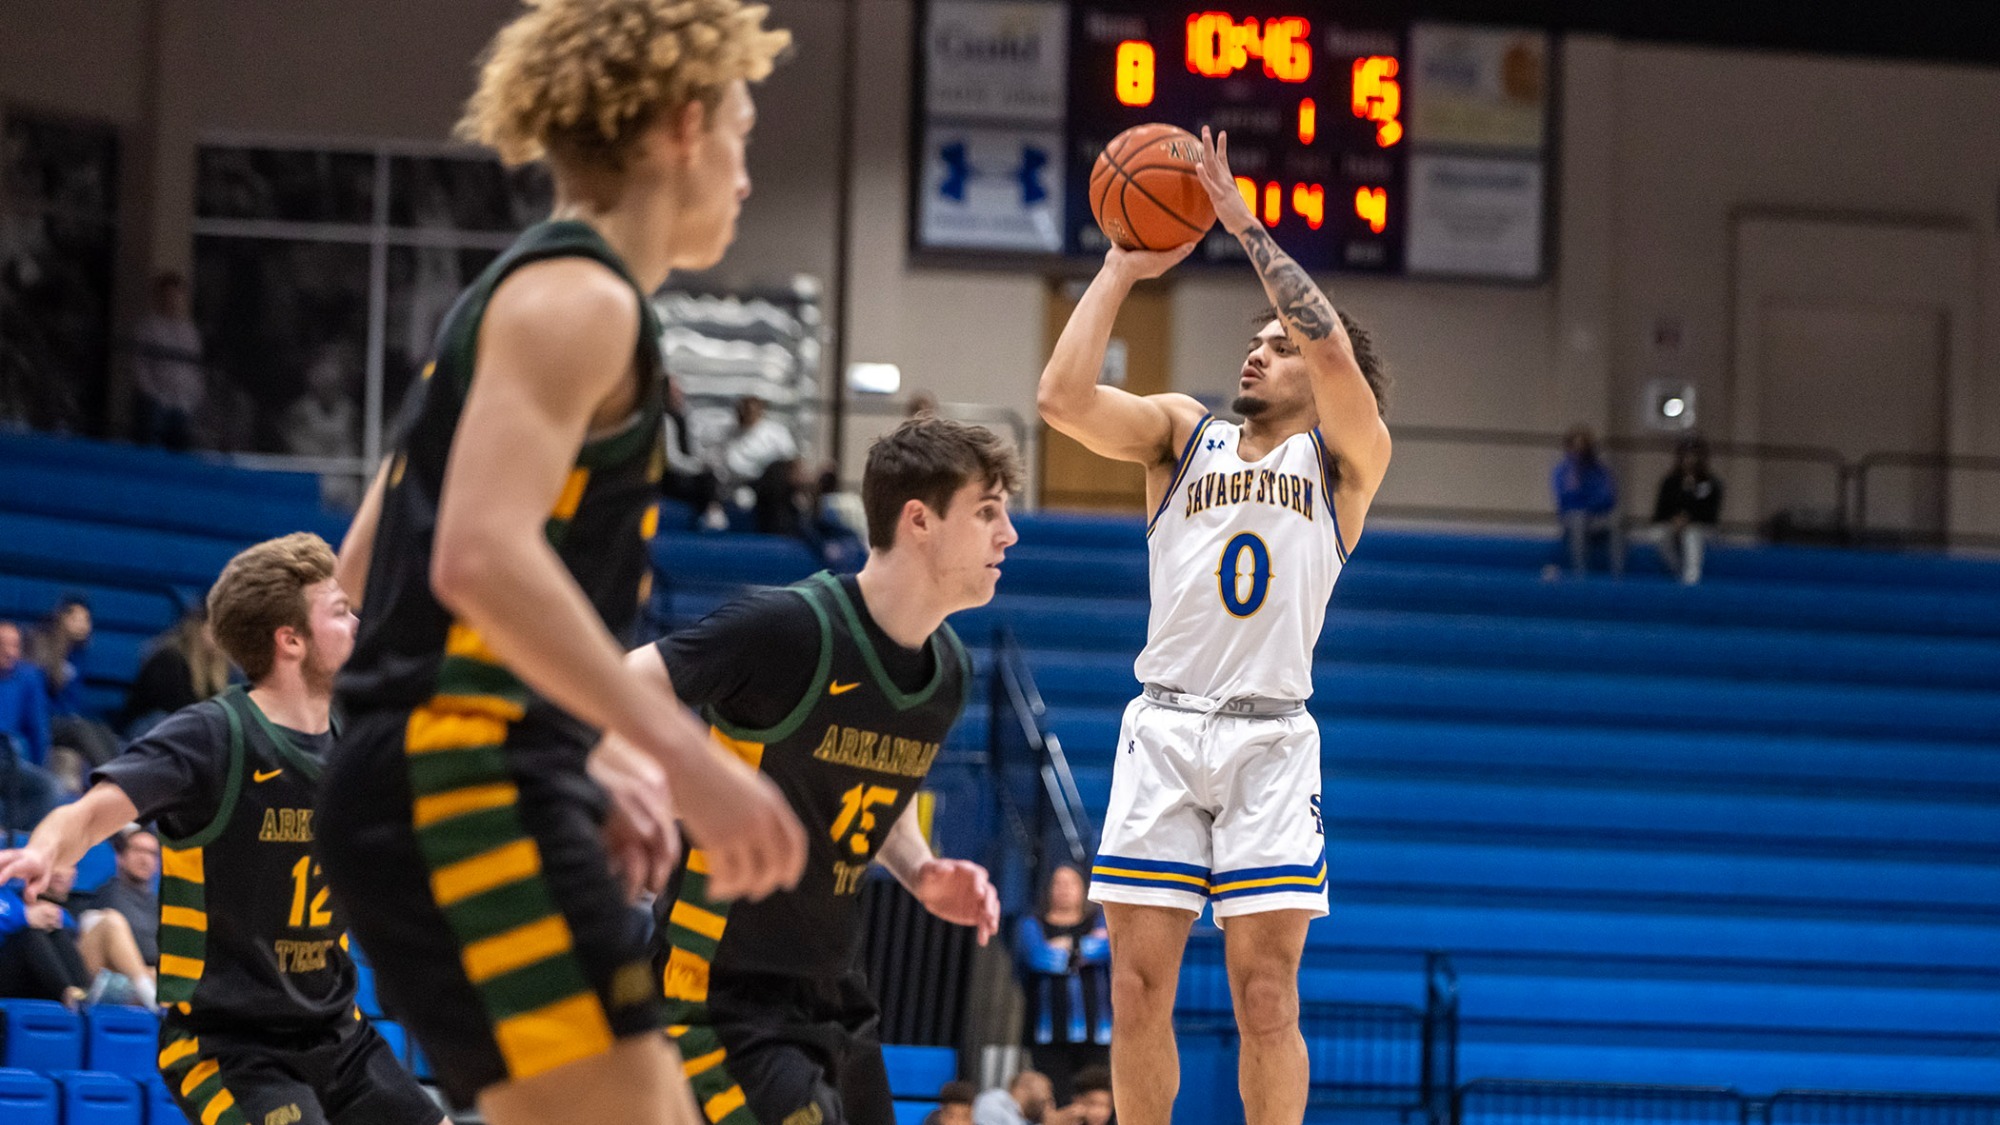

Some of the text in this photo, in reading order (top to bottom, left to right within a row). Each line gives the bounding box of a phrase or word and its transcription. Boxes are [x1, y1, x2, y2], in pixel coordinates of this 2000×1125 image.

[1186, 11, 1312, 83] 10:46
[1298, 97, 1316, 145] 1
[1352, 55, 1400, 121] 15
[1355, 185, 1387, 234] 4
[1185, 468, 1314, 522] SAVAGE STORM
[1215, 530, 1275, 619] 0
[829, 782, 898, 854] 15
[288, 855, 333, 927] 12
